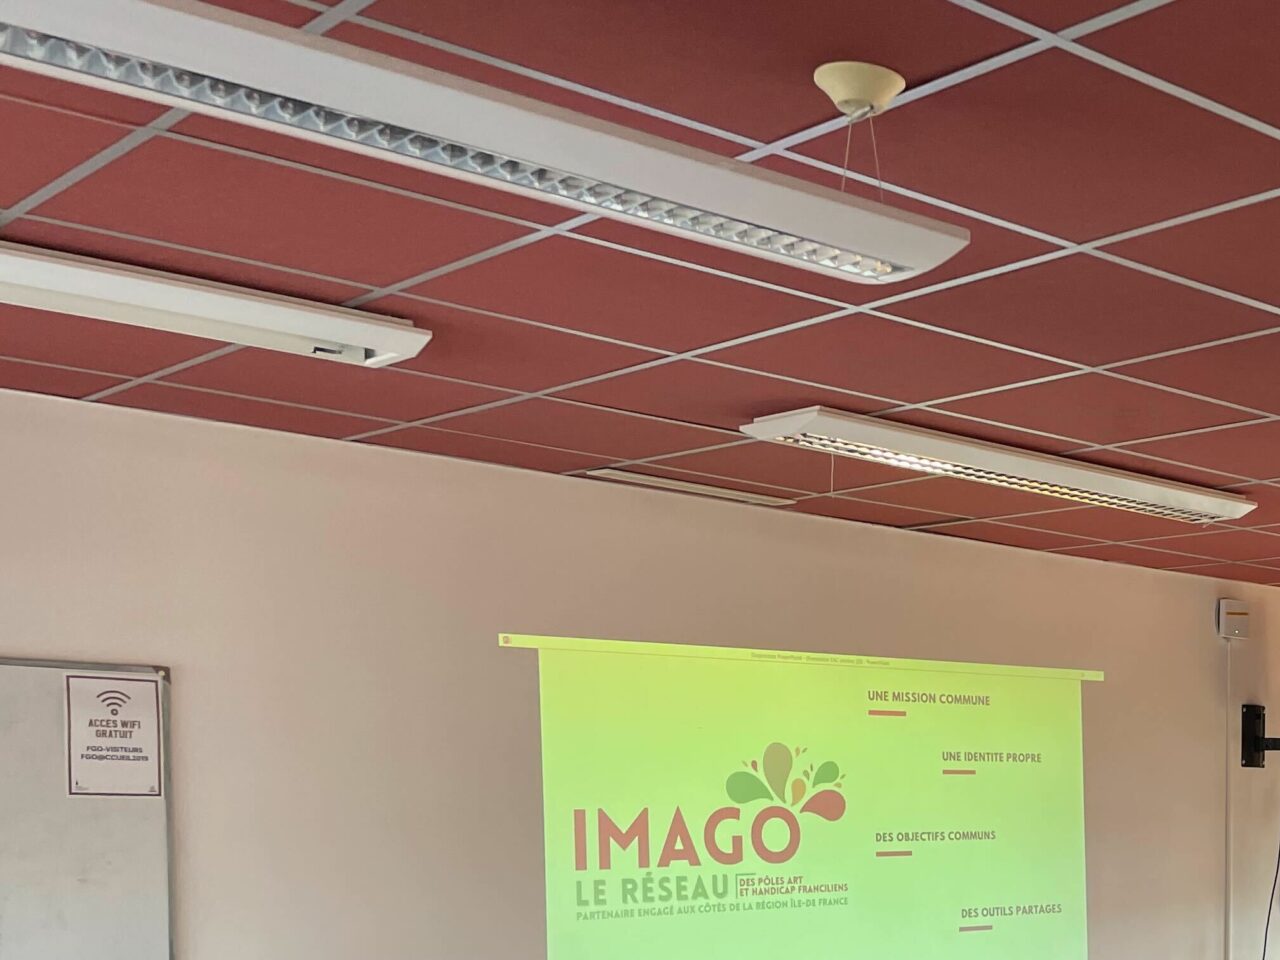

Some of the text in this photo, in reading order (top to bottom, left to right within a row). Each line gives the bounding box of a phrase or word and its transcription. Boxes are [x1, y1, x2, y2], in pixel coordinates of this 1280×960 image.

[867, 690, 991, 706] UNE MISSION COMMUNE
[120, 719, 141, 729] WIFI
[95, 729, 134, 739] GRATUIT
[941, 751, 1042, 763] UNE IDENTITE PROPRE
[573, 805, 801, 871] IMAGO
[875, 830, 997, 843] DES OBJECTIFS COMMUNS
[739, 875, 804, 887] DES PÔLES ART
[576, 871, 729, 907] LE RÉSEAU
[739, 883, 849, 897] ET HANDICAP FRANCILIENS
[576, 908, 635, 921] PARTENAIRE
[637, 905, 675, 917] ENGAGÉ
[676, 905, 696, 915] AUX
[698, 902, 727, 913] CÔTÉS
[729, 903, 741, 912] DE
[743, 902, 754, 911] LA
[755, 899, 788, 910] RÉGION
[818, 897, 849, 906] FRANCE
[961, 904, 1062, 919] DES OUTILS PARTAGES
